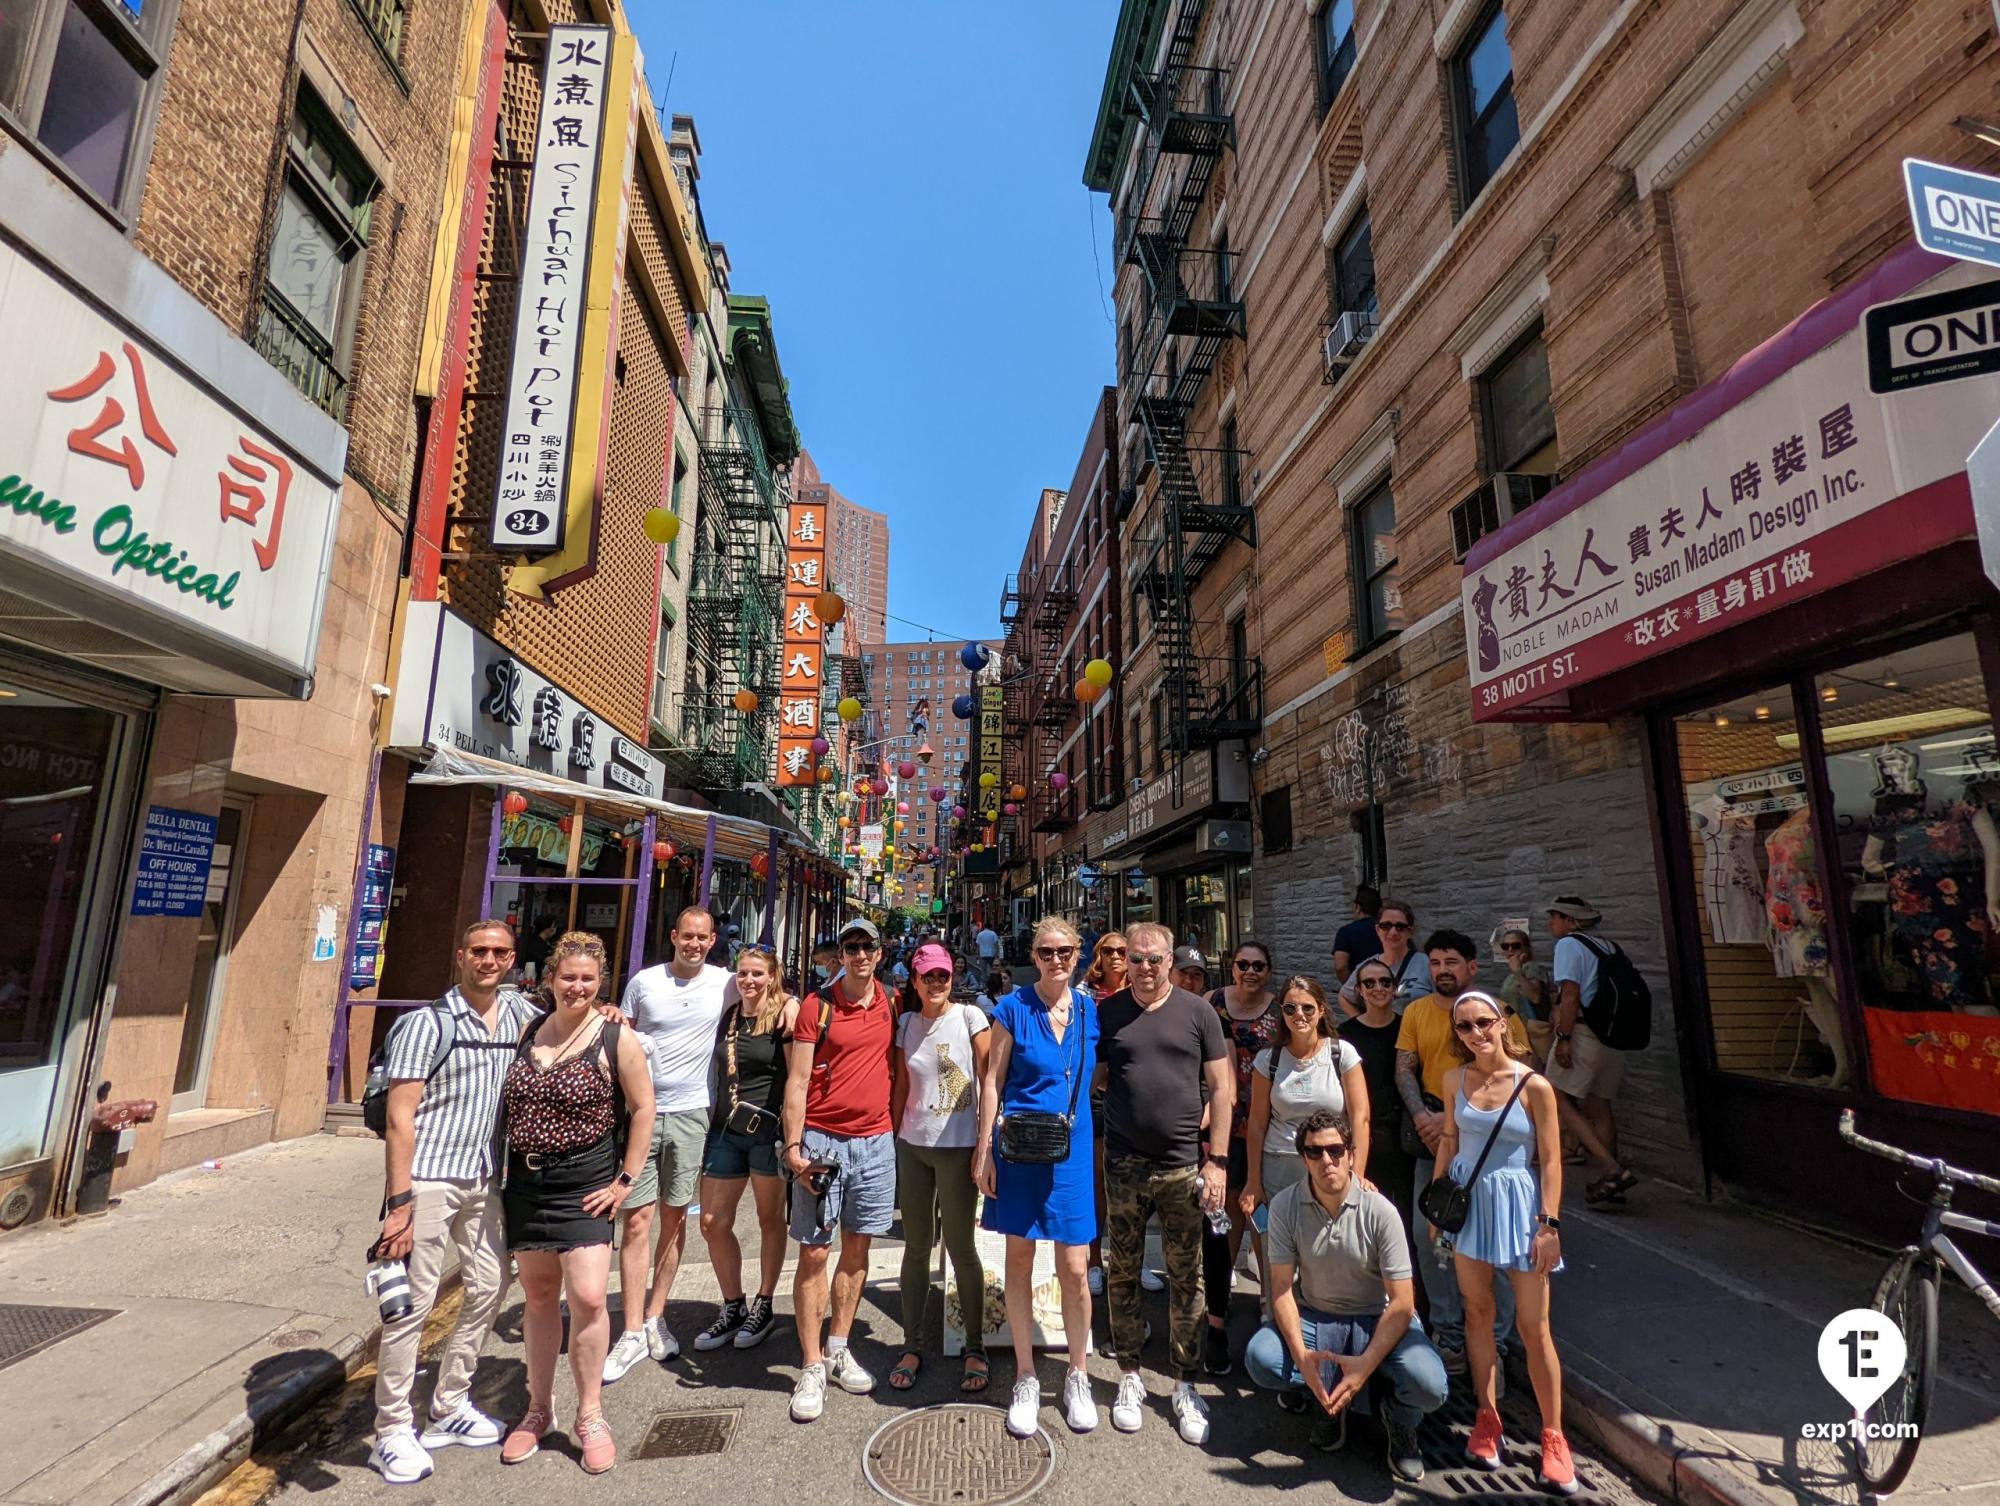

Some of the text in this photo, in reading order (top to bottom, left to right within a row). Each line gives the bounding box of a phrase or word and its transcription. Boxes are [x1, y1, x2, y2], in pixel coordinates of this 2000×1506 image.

[547, 38, 602, 149] 水煮魚
[524, 163, 580, 427] Sichuan Hot Pot
[47, 340, 294, 571] 公司
[502, 433, 531, 501] 四川小炒
[1627, 402, 1858, 565] 貴夫人時裝屋
[93, 504, 241, 610] Optical
[511, 511, 540, 532] 34
[1634, 468, 1866, 597] Susan Madam Design Inc.
[1499, 527, 1618, 623] 貴夫人
[783, 511, 821, 777] 喜運來大酒家
[1503, 597, 1619, 662] NOBLE MADAM
[485, 660, 596, 771] 水煮魚
[1482, 652, 1580, 707] 38 MOTT ST.
[438, 723, 450, 742] 34
[454, 730, 478, 754] PELL
[148, 812, 176, 828] BELLA
[178, 818, 211, 833] DENTAL
[149, 858, 197, 873] OFF HOURS
[156, 839, 172, 851] Wen
